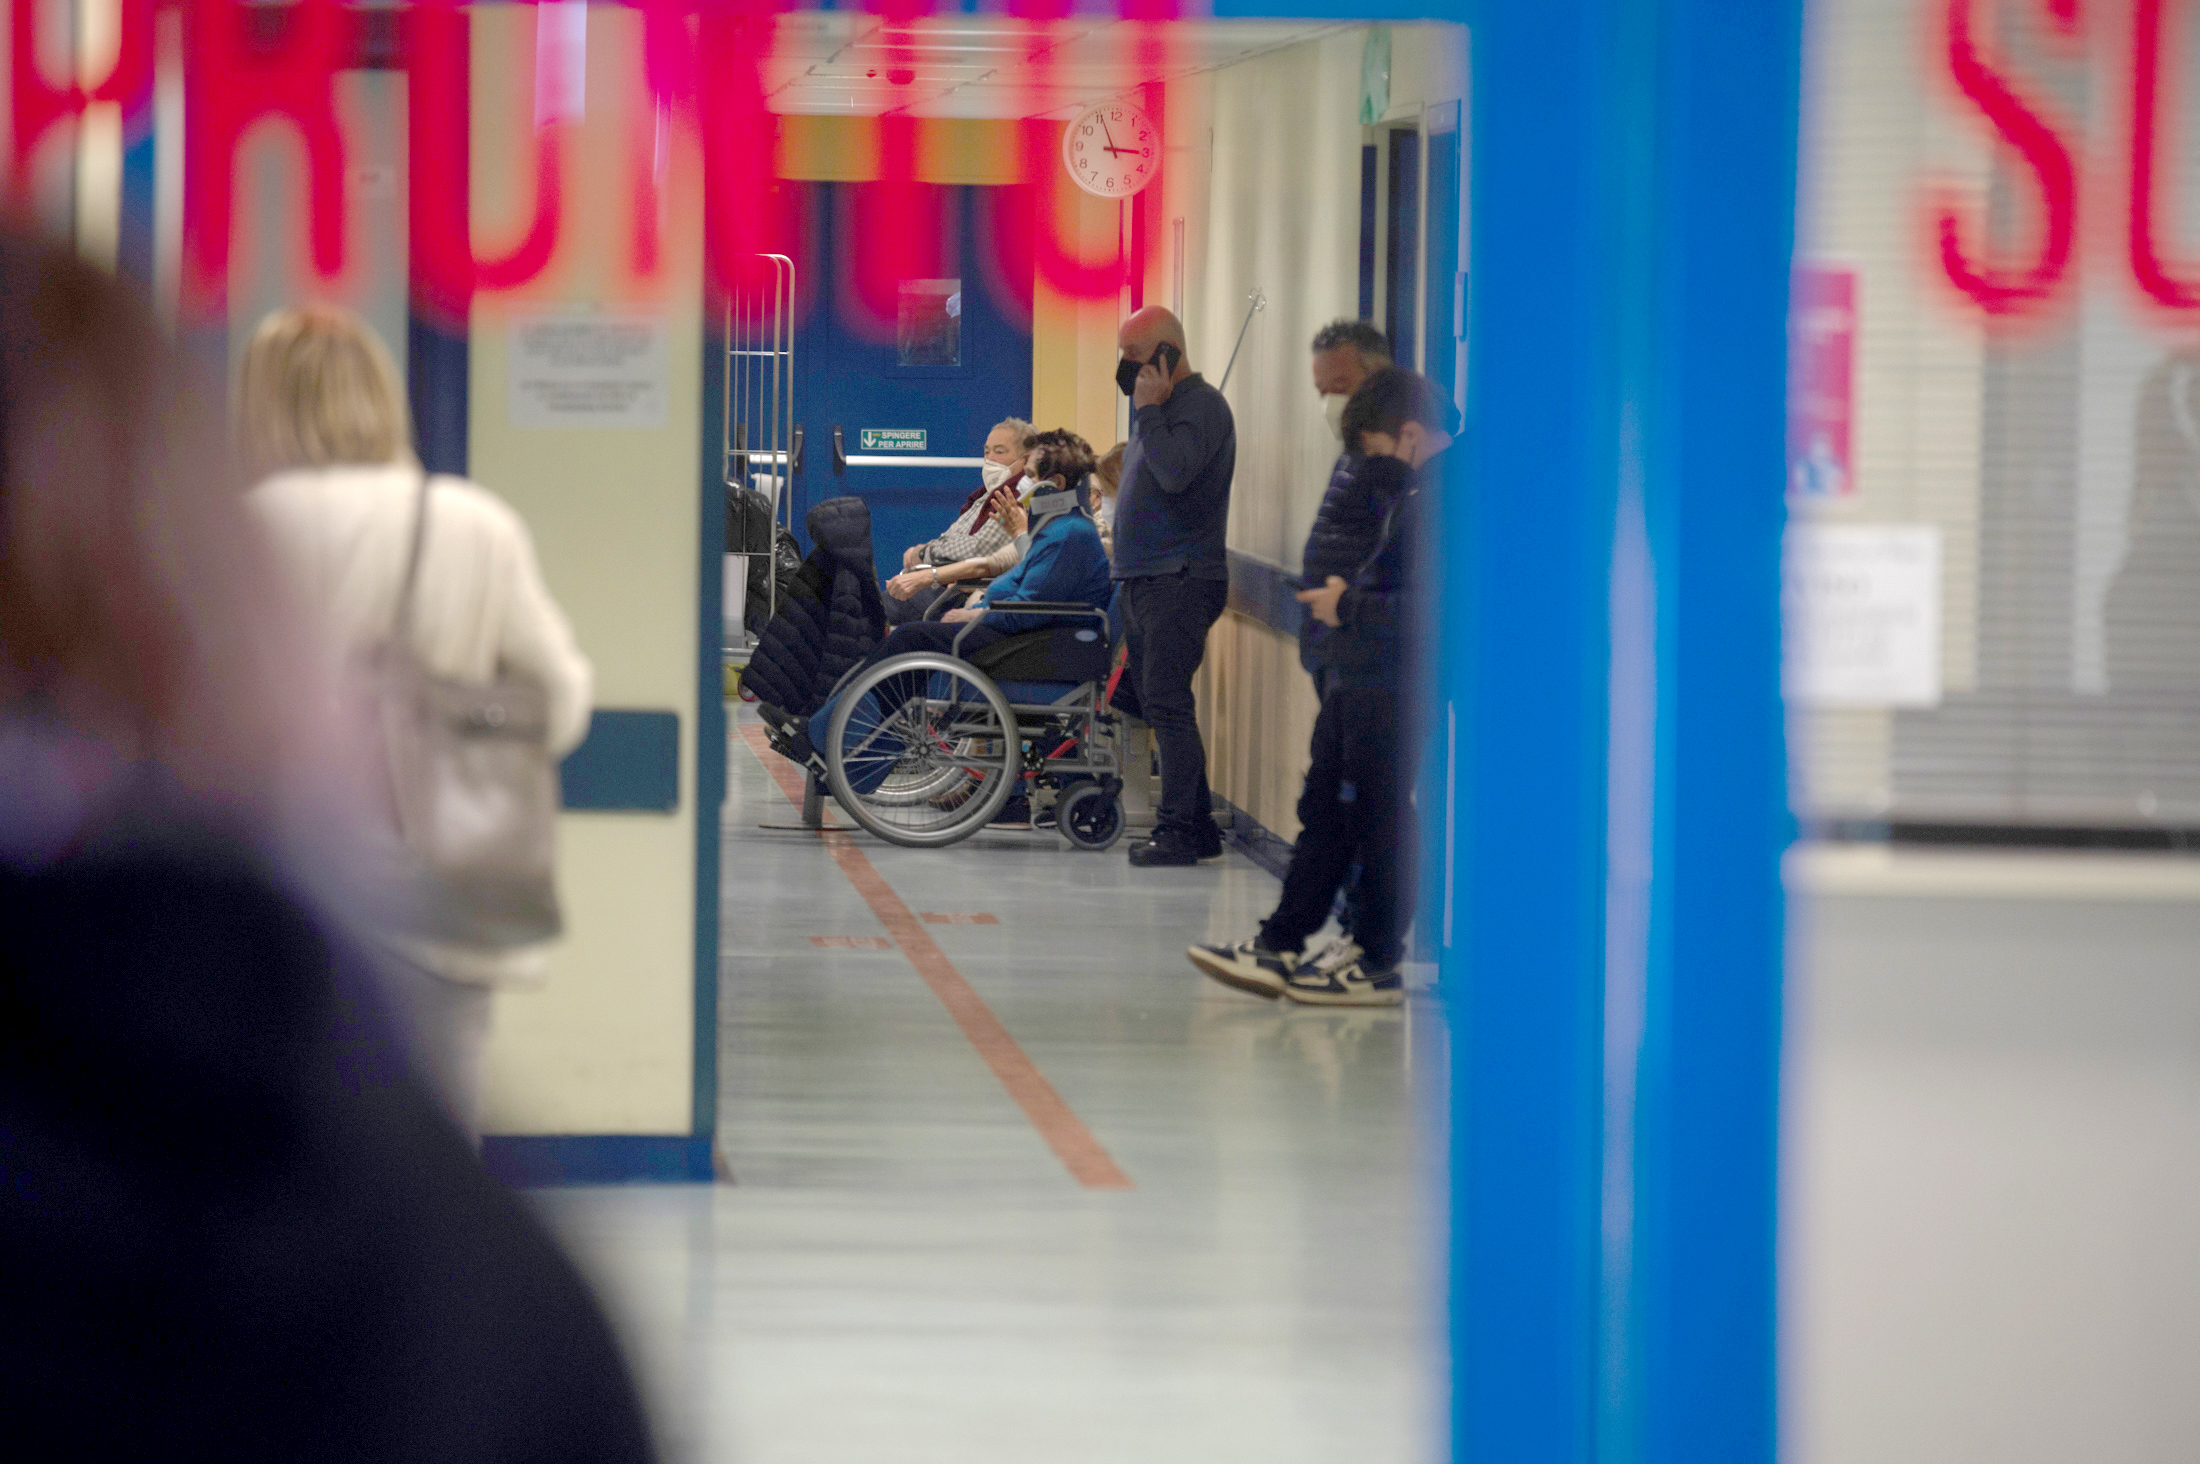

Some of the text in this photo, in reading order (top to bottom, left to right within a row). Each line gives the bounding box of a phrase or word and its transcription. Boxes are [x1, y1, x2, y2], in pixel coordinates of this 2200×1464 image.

[1096, 114, 1104, 124] 11
[1111, 111, 1123, 122] 12
[1082, 125, 1094, 136] 10
[1139, 130, 1148, 141] 2
[1075, 141, 1084, 151] 9
[1142, 147, 1150, 158] 3
[1079, 158, 1088, 169] 8
[1136, 164, 1144, 173] 4
[1090, 171, 1098, 181] 7
[1123, 174, 1131, 185] 5
[1106, 177, 1114, 188] 6
